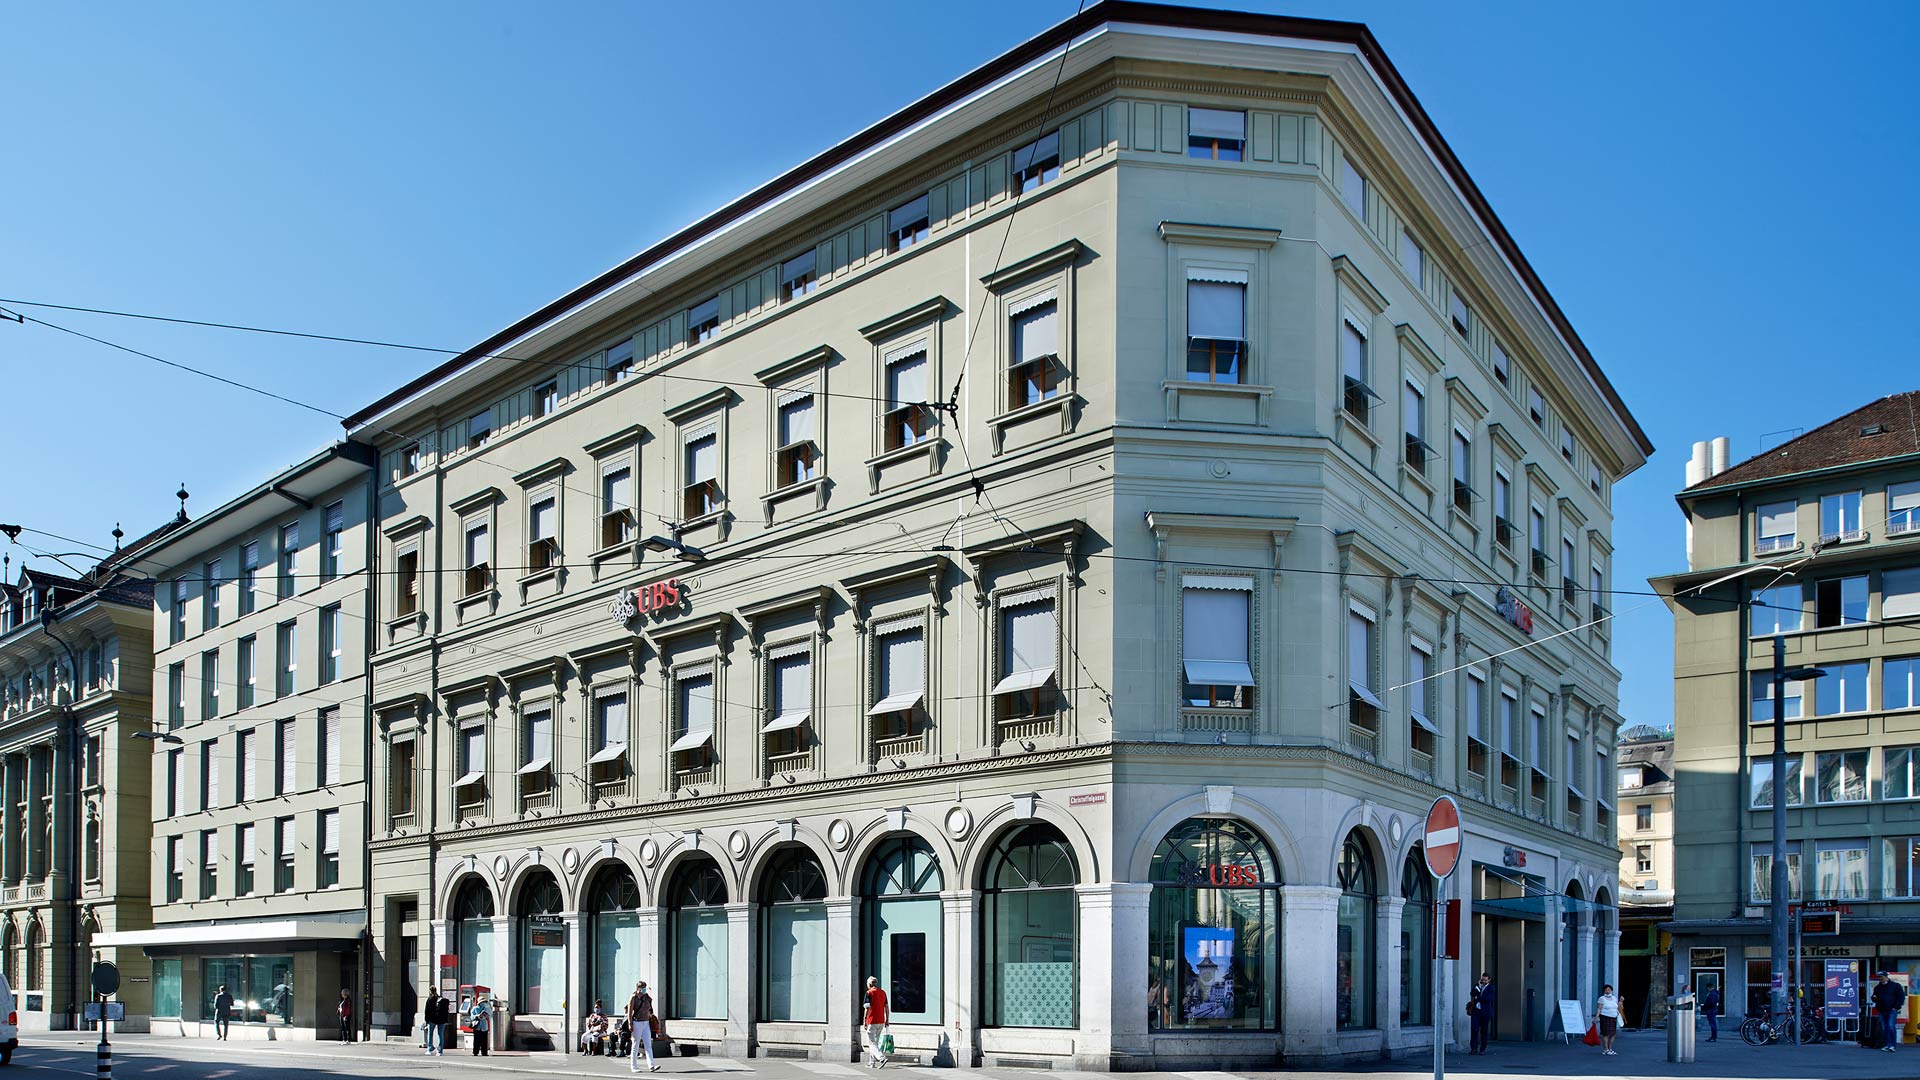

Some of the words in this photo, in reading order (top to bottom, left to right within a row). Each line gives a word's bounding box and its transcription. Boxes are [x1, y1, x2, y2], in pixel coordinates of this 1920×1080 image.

[638, 578, 679, 614] UBS
[1515, 599, 1534, 635] UBS
[1209, 863, 1257, 887] UBS
[1810, 946, 1850, 956] Tickets
